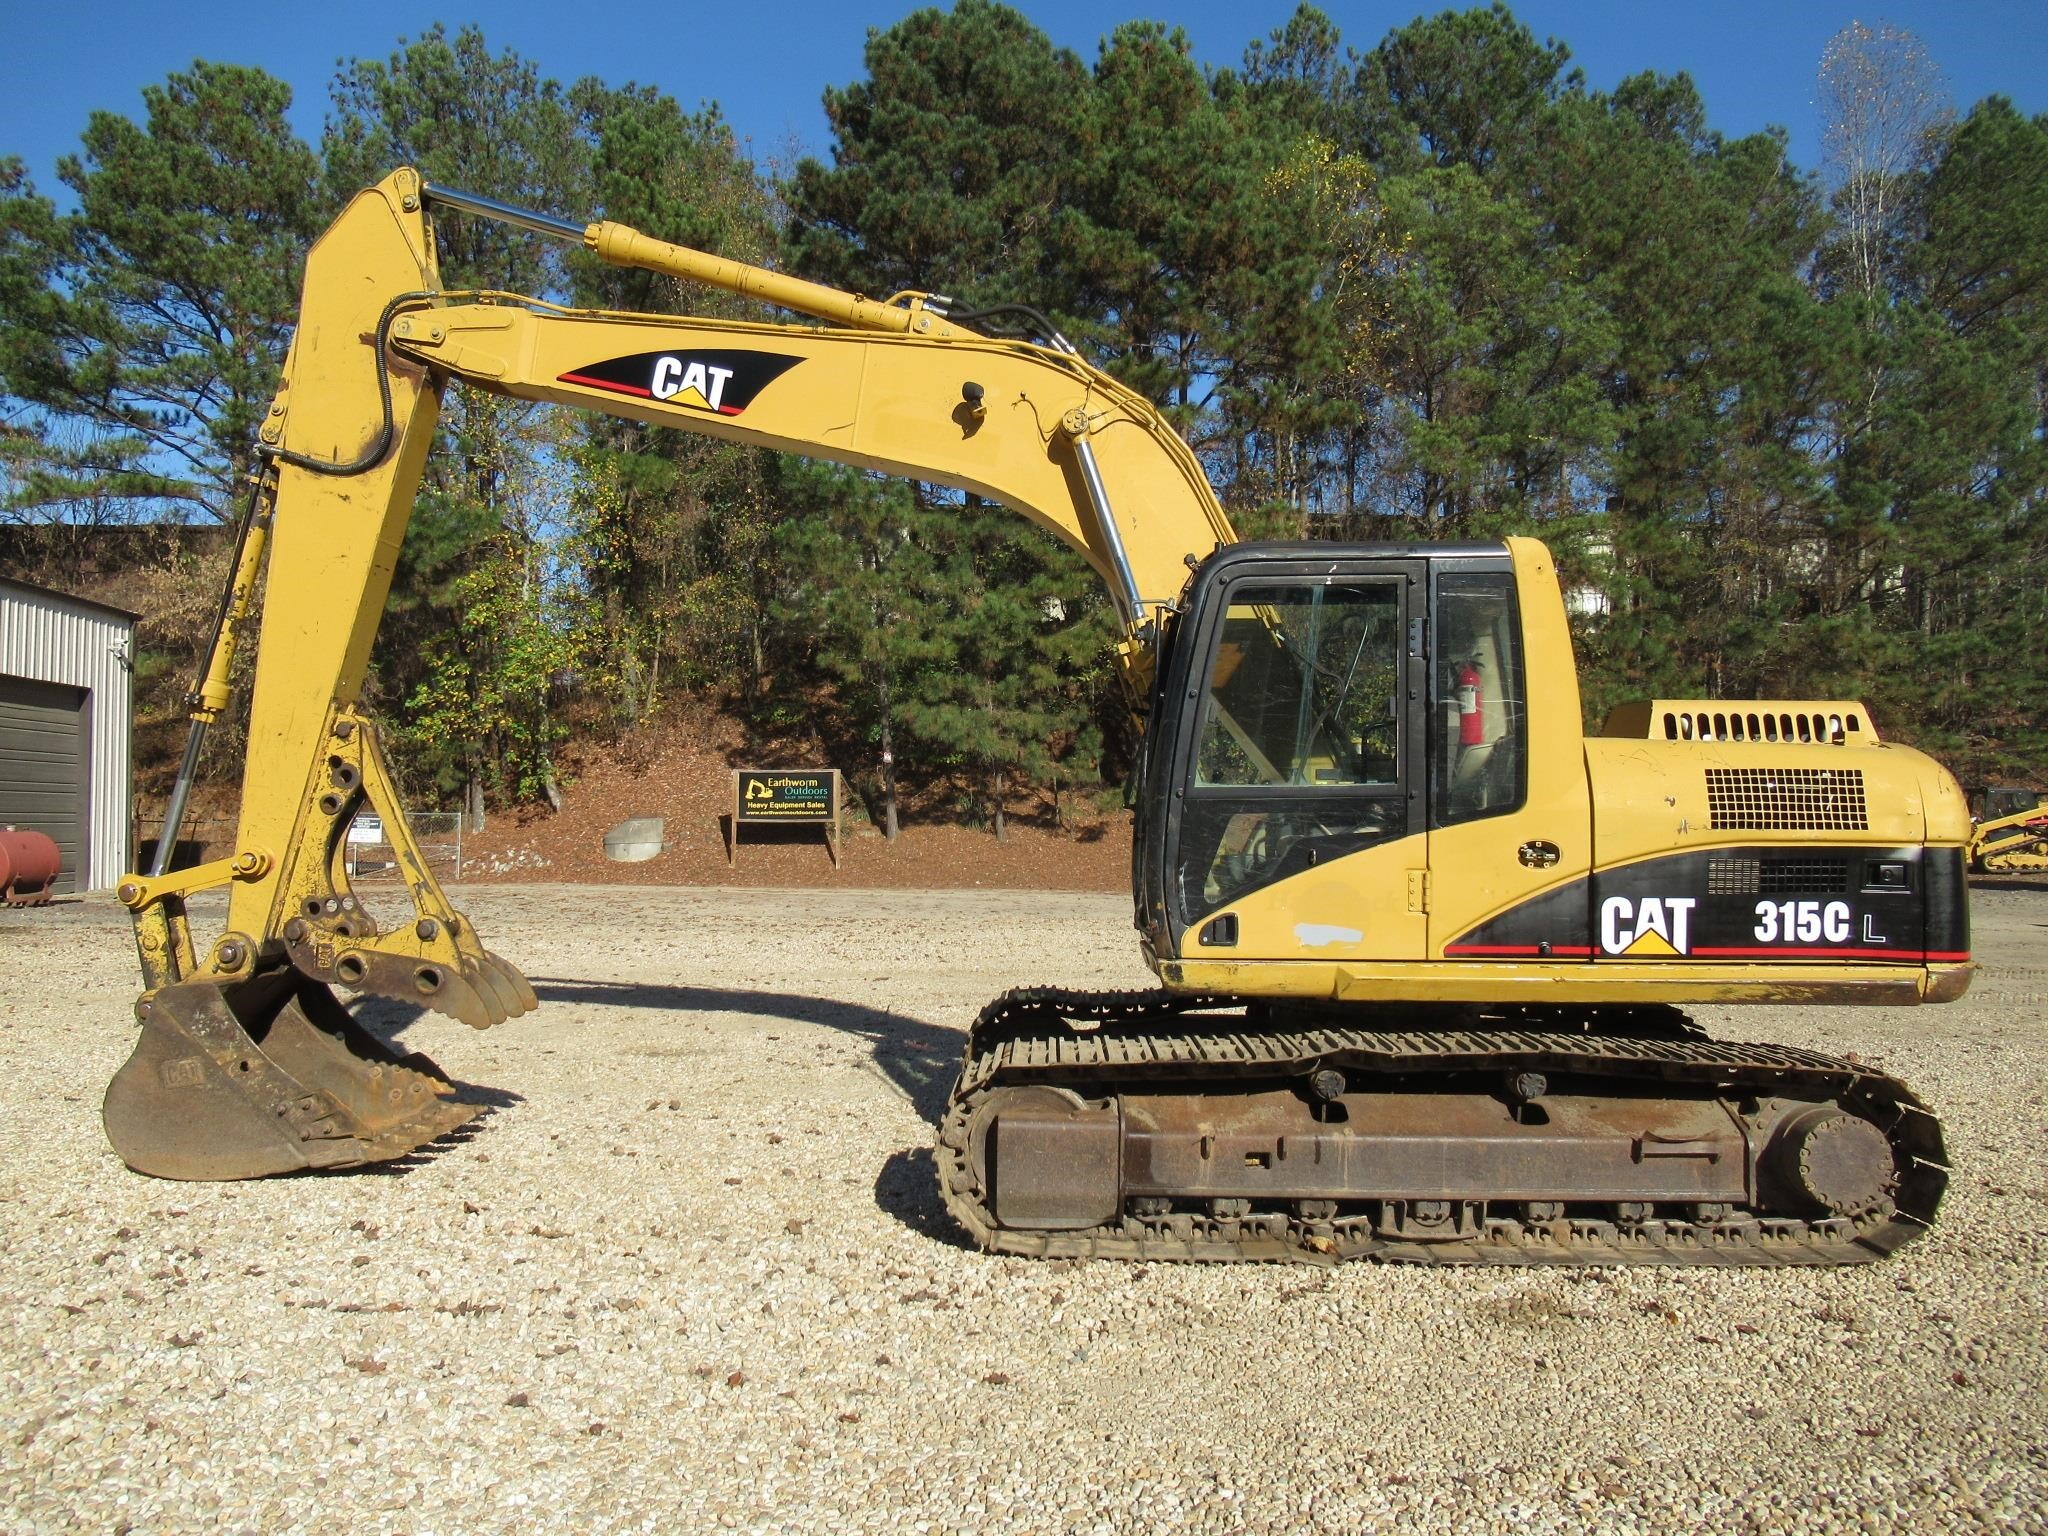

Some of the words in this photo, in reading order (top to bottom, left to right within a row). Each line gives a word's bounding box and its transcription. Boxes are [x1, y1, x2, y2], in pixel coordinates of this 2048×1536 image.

[651, 356, 734, 411] CAT
[768, 777, 818, 786] Earthworm
[784, 786, 828, 795] Outdoors
[1600, 896, 1696, 955] CAT
[1754, 901, 1850, 942] 315C
[1863, 914, 1886, 942] L
